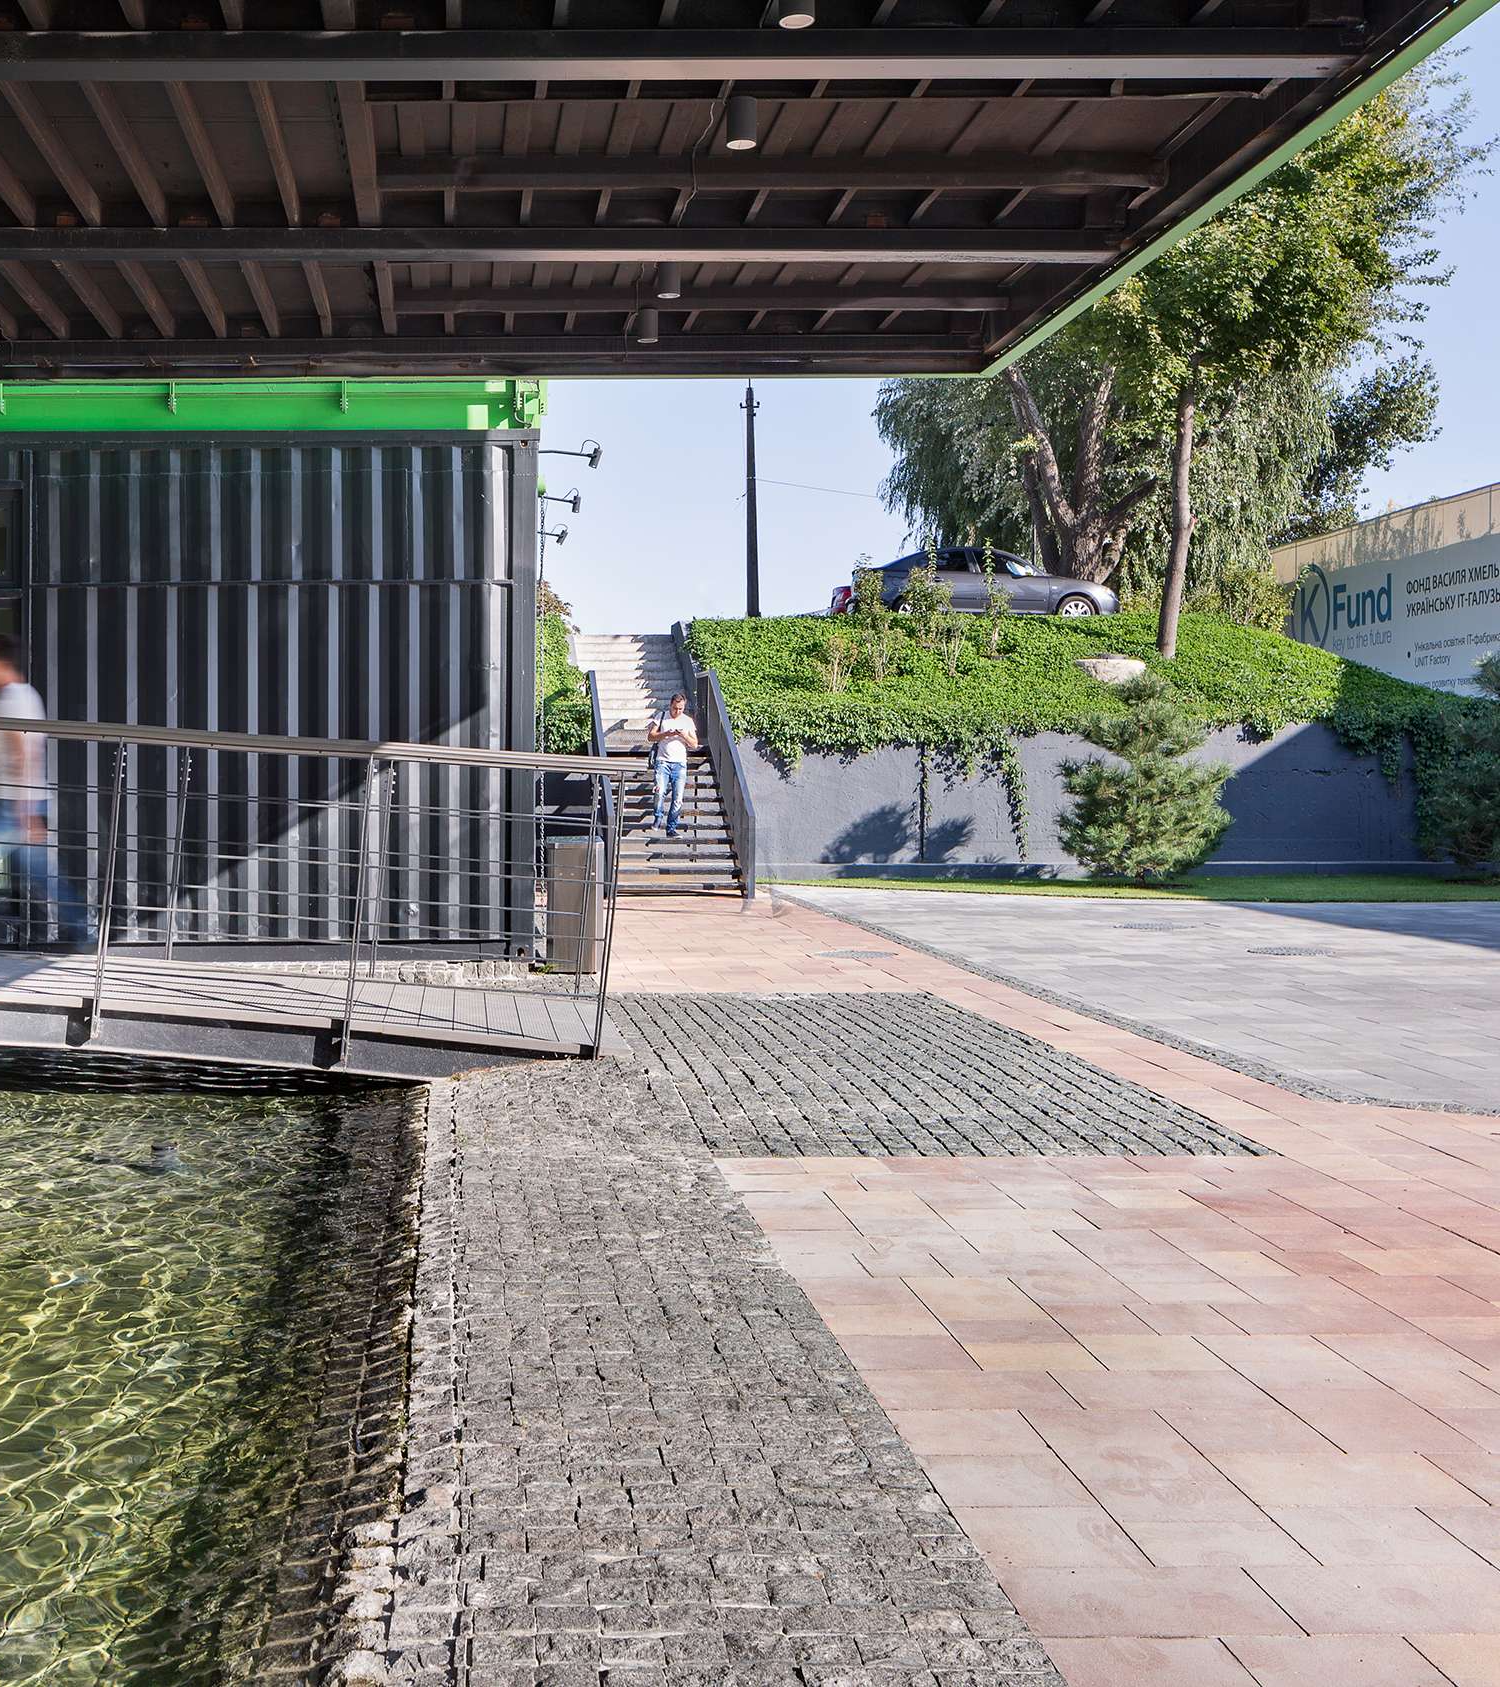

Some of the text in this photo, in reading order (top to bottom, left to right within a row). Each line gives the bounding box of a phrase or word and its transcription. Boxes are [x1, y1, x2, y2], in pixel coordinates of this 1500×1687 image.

[1406, 577, 1431, 595] ФОНД
[1432, 569, 1467, 590] ВАСИЛЯ
[1333, 573, 1392, 631] Fund
[1406, 594, 1457, 618] УКРАЇНСЬКУ
[1333, 629, 1392, 654] key to the future
[1429, 654, 1451, 666] Factory
